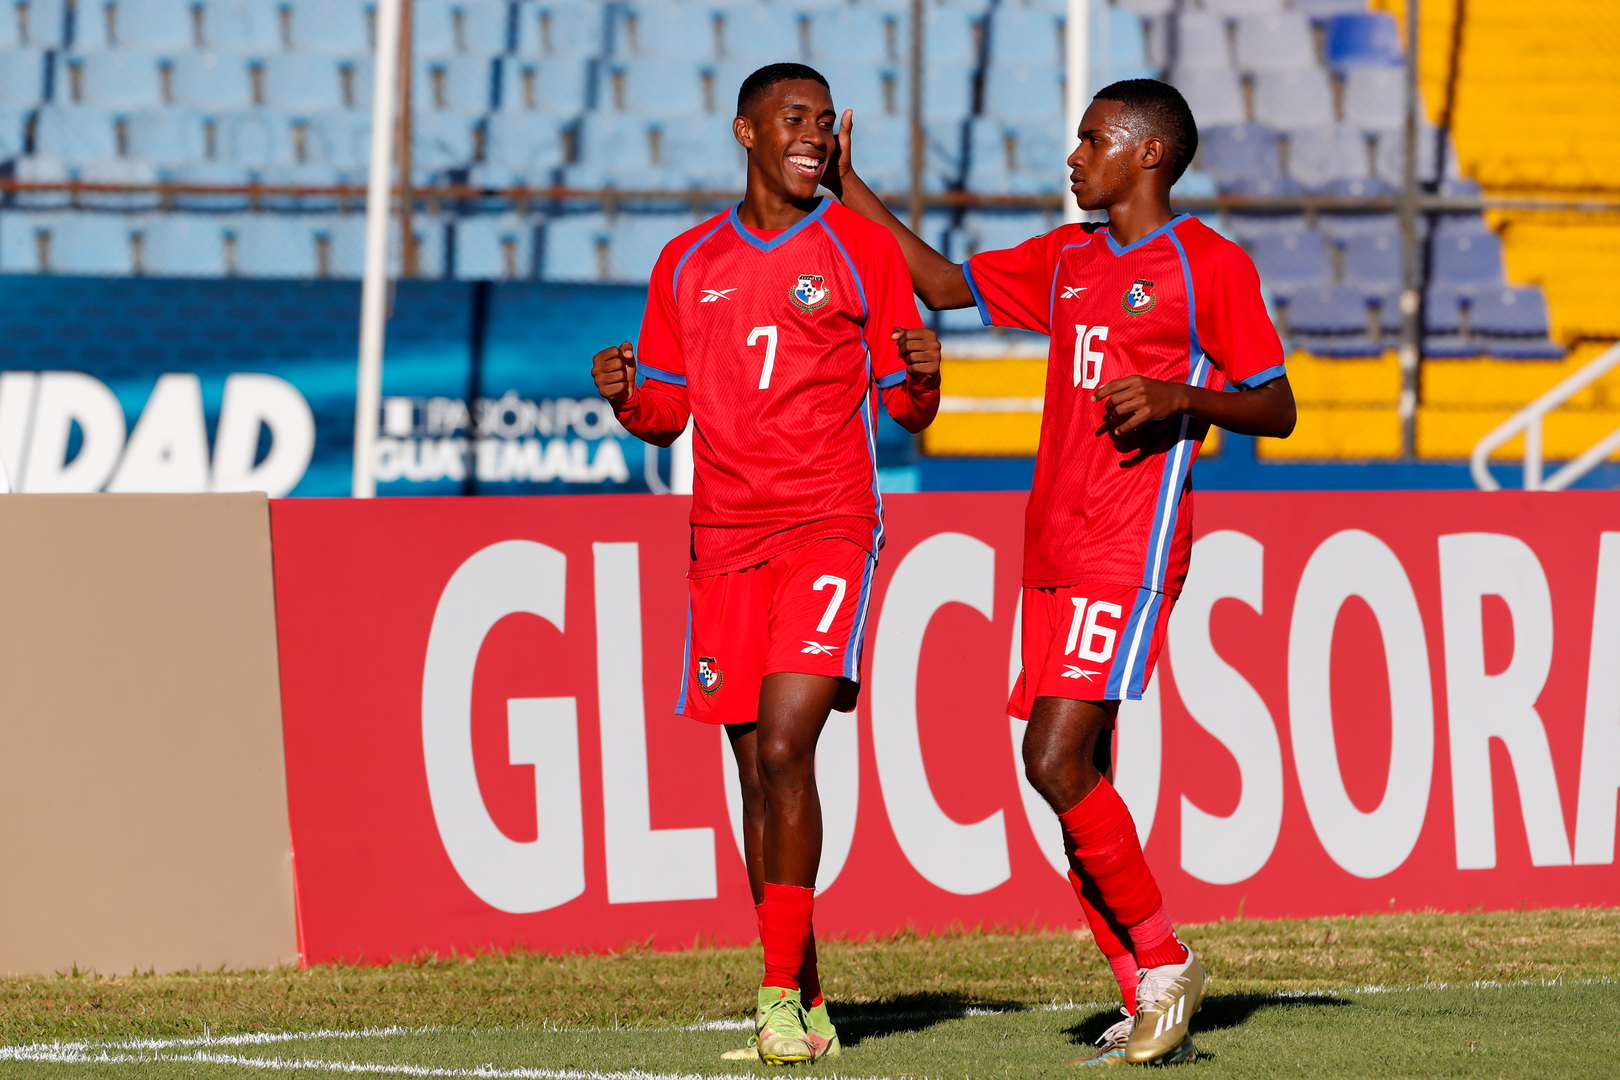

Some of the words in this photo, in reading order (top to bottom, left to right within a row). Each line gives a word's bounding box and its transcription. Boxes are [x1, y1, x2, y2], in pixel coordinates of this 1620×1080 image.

[746, 325, 778, 390] 7
[1073, 324, 1109, 389] 16
[813, 574, 846, 633] 7
[1064, 597, 1122, 663] 16
